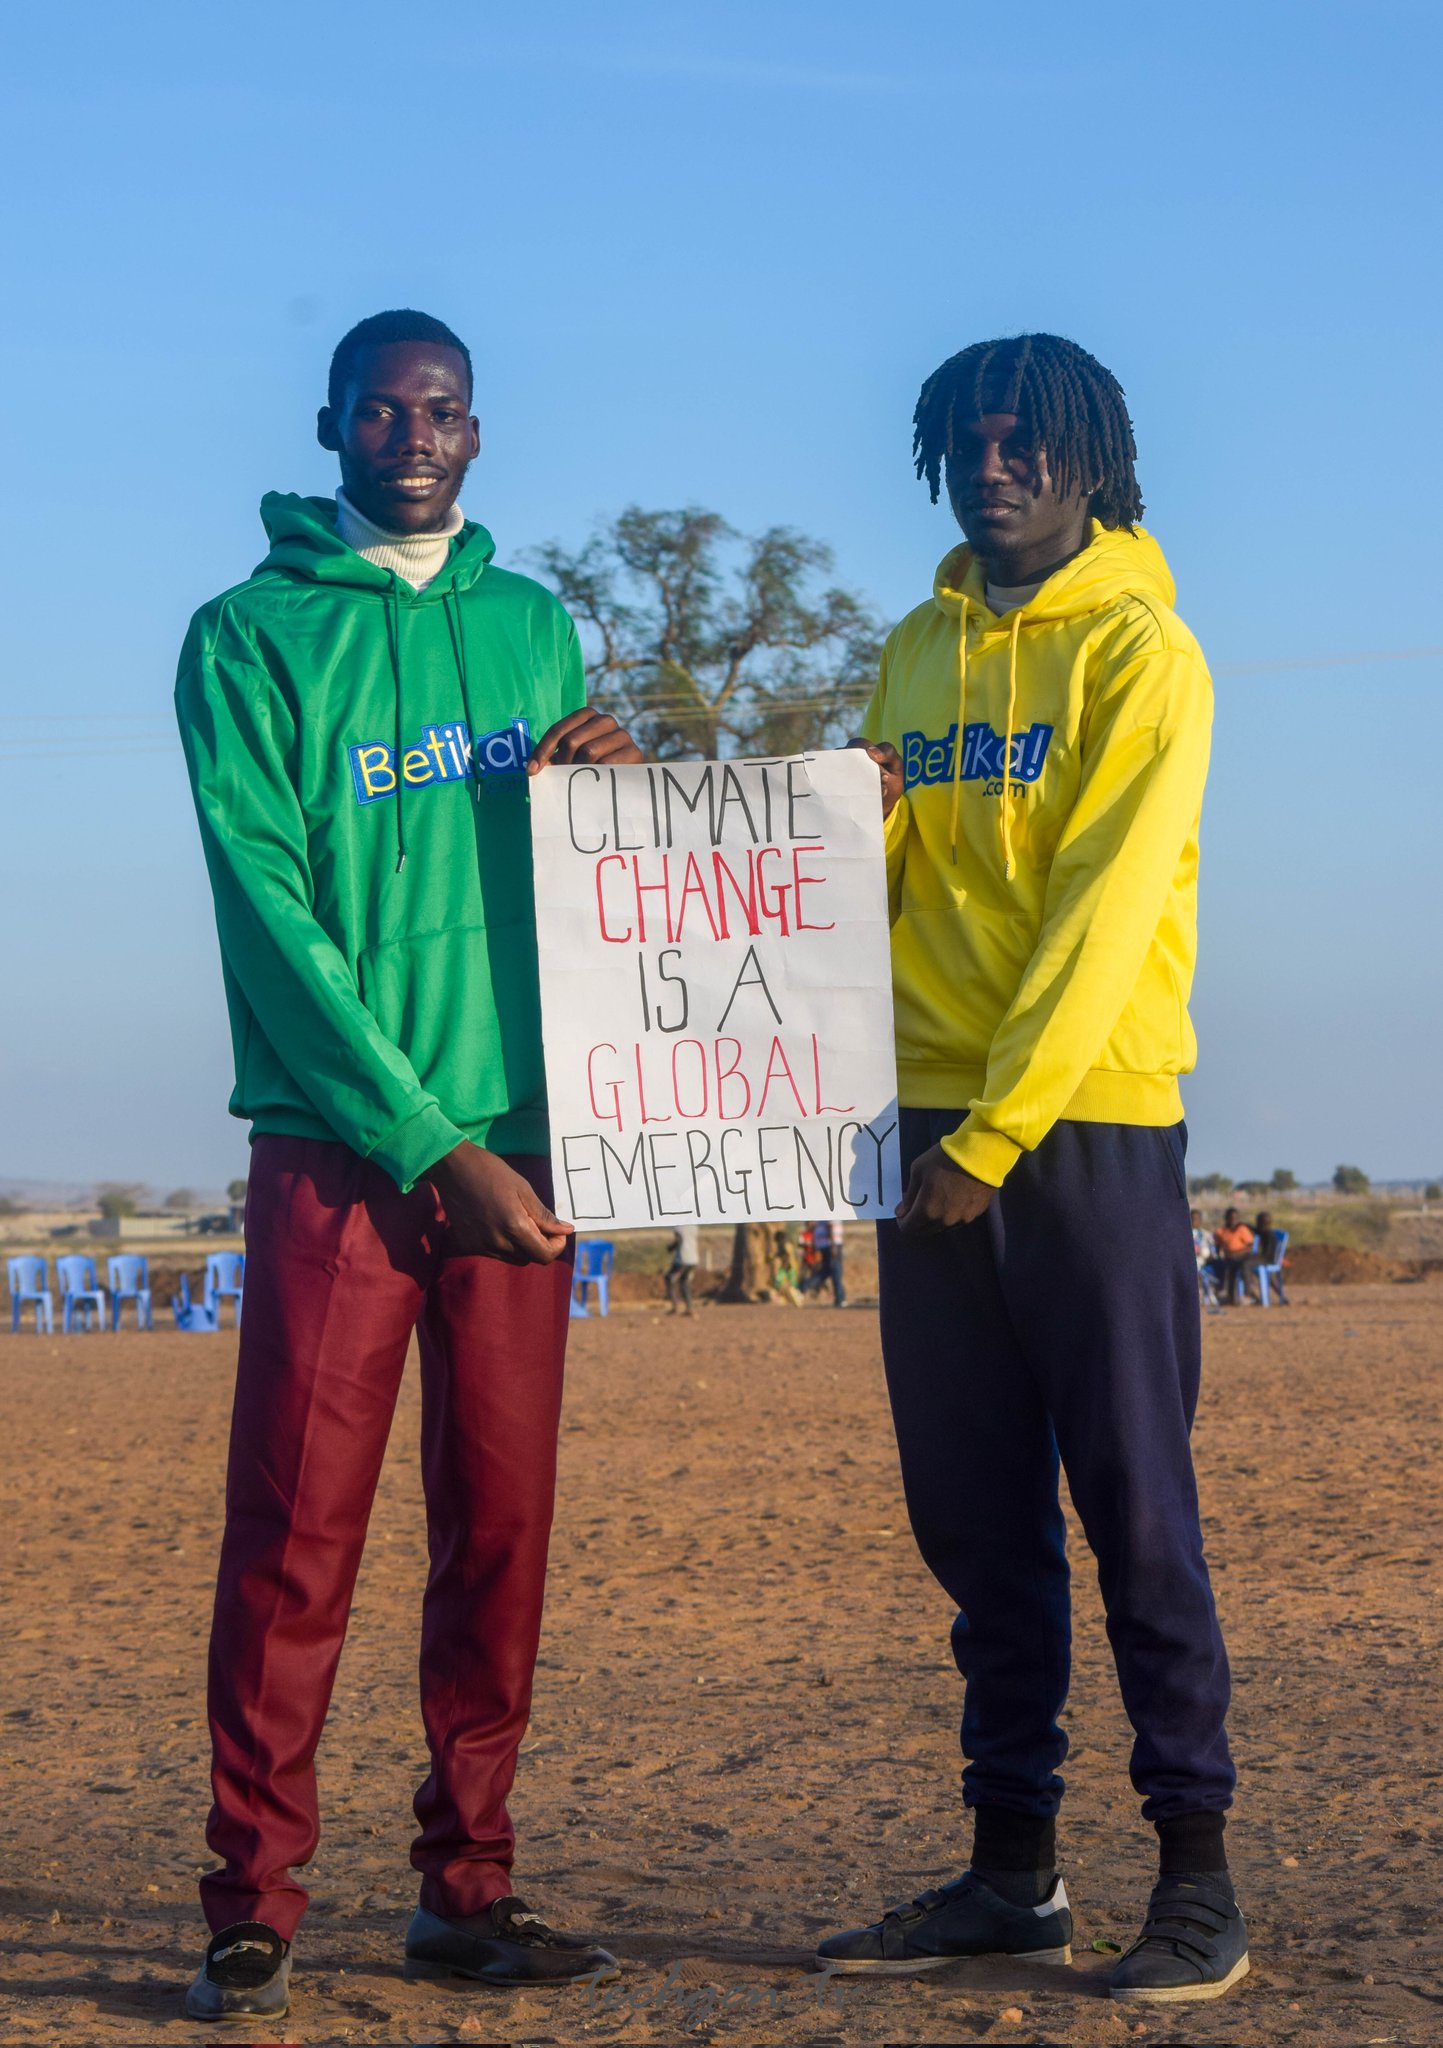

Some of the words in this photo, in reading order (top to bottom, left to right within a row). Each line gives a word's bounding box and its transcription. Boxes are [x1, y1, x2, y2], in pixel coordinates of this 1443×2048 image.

[357, 722, 529, 797] Betika!
[905, 727, 1046, 784] Betika!
[982, 781, 1026, 799] .com
[567, 757, 823, 855] CLIMATE
[594, 845, 836, 944] CHANGE
[637, 949, 689, 1033] IS
[716, 944, 783, 1033] A
[586, 1032, 857, 1133] GLOBAL
[561, 1121, 898, 1221] EMERGENCY
